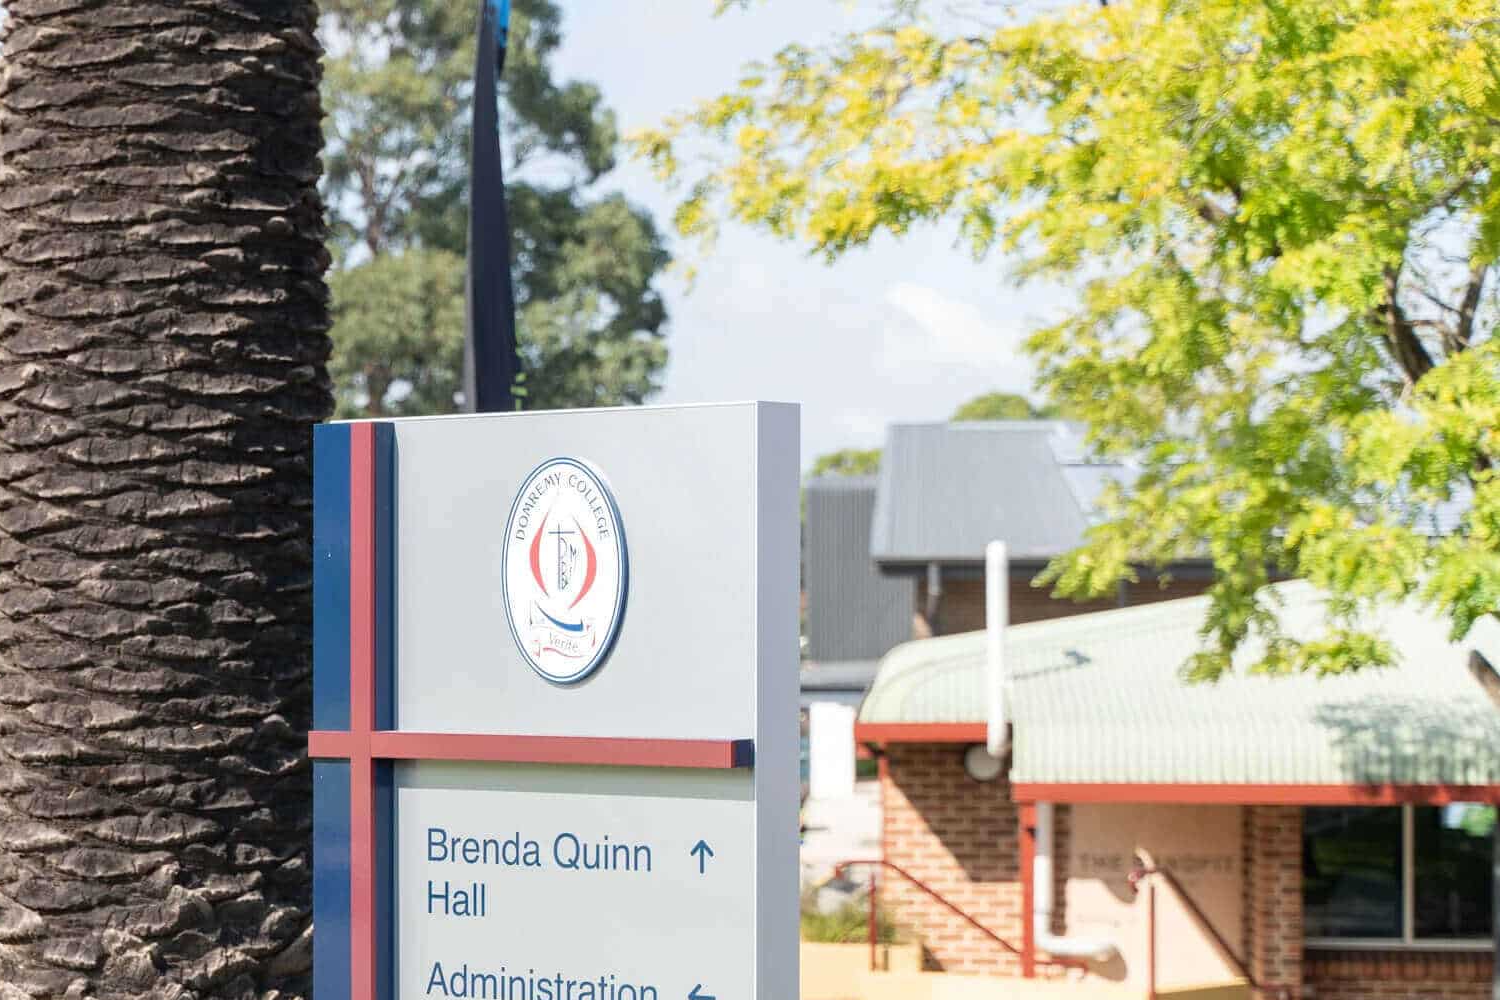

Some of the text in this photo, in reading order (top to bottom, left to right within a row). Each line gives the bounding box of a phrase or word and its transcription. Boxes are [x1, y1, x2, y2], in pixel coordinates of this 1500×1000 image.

[515, 471, 610, 541] DOMREMY COLLEGE
[427, 827, 652, 872] Brenda Quinn
[427, 879, 486, 917] Hall
